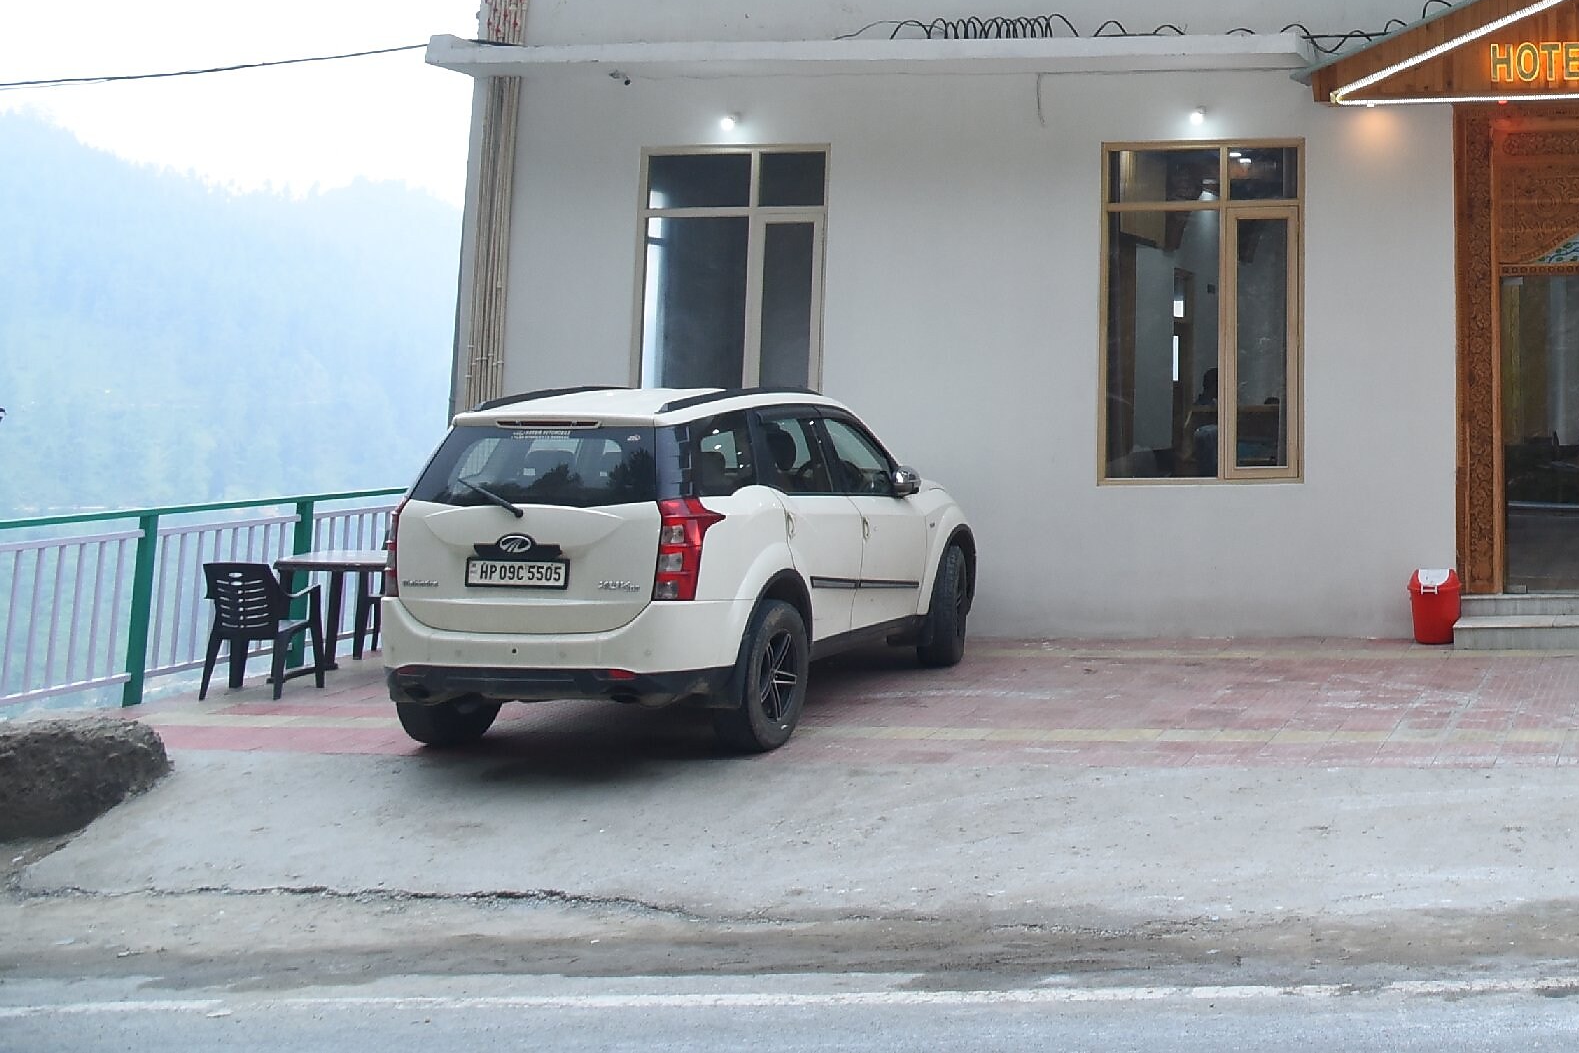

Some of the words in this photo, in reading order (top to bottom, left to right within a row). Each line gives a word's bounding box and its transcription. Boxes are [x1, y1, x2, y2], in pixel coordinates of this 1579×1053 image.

[480, 563, 498, 580] HP
[499, 565, 524, 581] 09C
[527, 565, 562, 582] 5505
